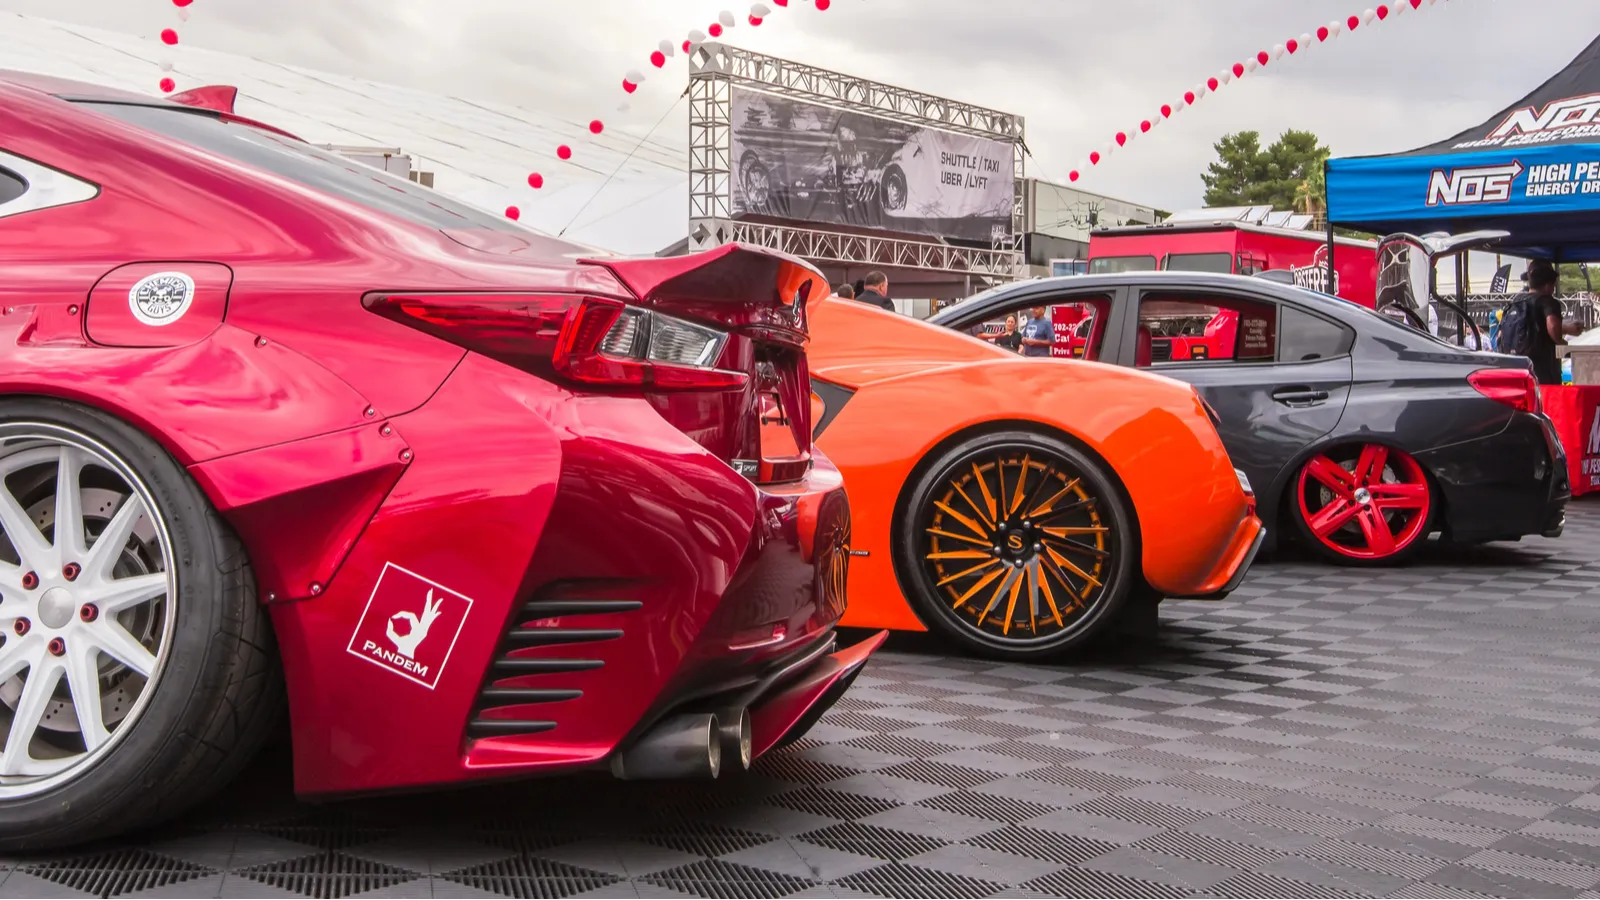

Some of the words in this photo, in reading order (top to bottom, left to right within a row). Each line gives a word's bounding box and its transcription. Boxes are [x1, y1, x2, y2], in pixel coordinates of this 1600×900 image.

[1486, 93, 1600, 139] NO
[941, 151, 977, 169] SHUTTLE
[941, 171, 962, 186] UBER
[1527, 163, 1572, 183] HIGH
[1574, 161, 1600, 181] PE
[1427, 161, 1523, 206] NOS
[1525, 181, 1578, 197] ENERGY
[138, 277, 184, 295] CHEMICAL
[147, 303, 171, 314] GUYS
[1007, 534, 1023, 549] S
[363, 640, 429, 677] PANDEM
